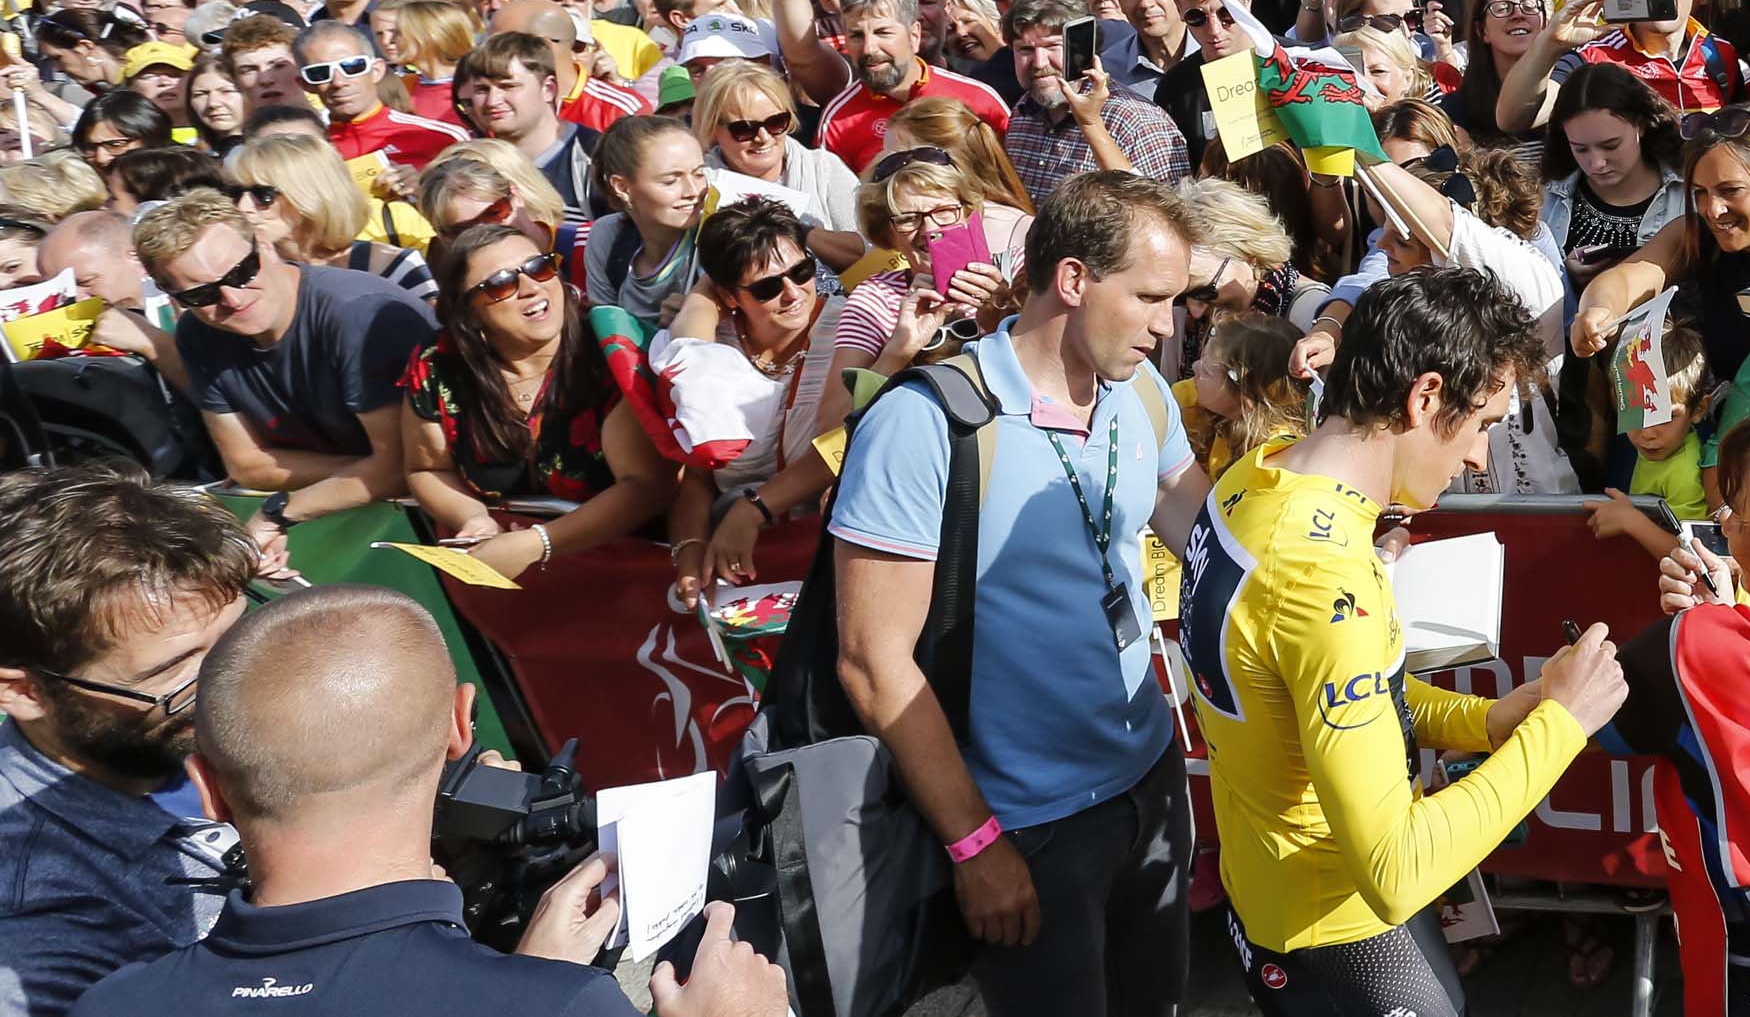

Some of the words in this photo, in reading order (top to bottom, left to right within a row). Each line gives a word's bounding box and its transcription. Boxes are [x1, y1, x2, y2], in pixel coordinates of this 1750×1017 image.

[1309, 508, 1335, 538] LCL
[1152, 564, 1166, 613] Dream
[1325, 672, 1388, 708] LCL
[232, 977, 314, 998] PINARELLO
